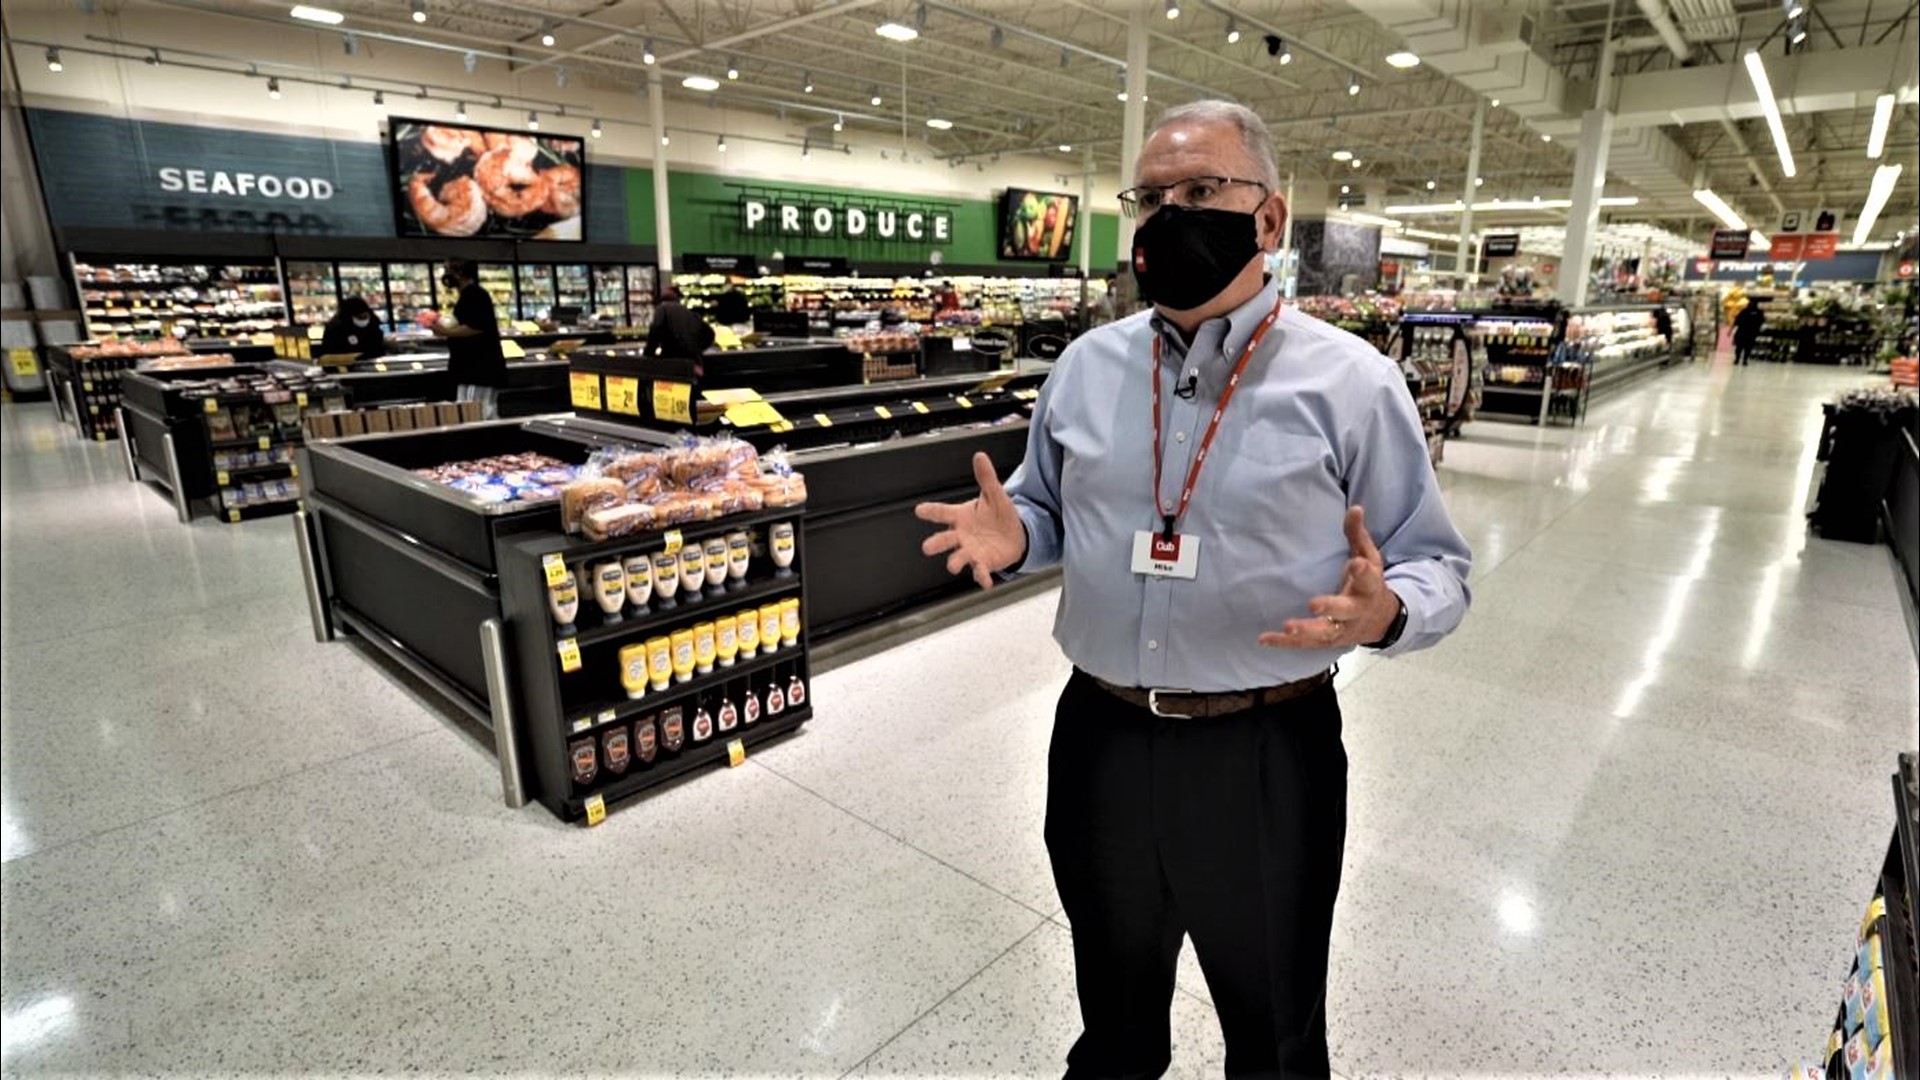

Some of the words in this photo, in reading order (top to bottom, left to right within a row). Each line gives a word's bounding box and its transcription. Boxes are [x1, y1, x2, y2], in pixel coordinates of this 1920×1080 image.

[158, 167, 334, 200] SEAFOOD
[746, 202, 949, 239] PRODUCE
[1156, 541, 1175, 553] Cub
